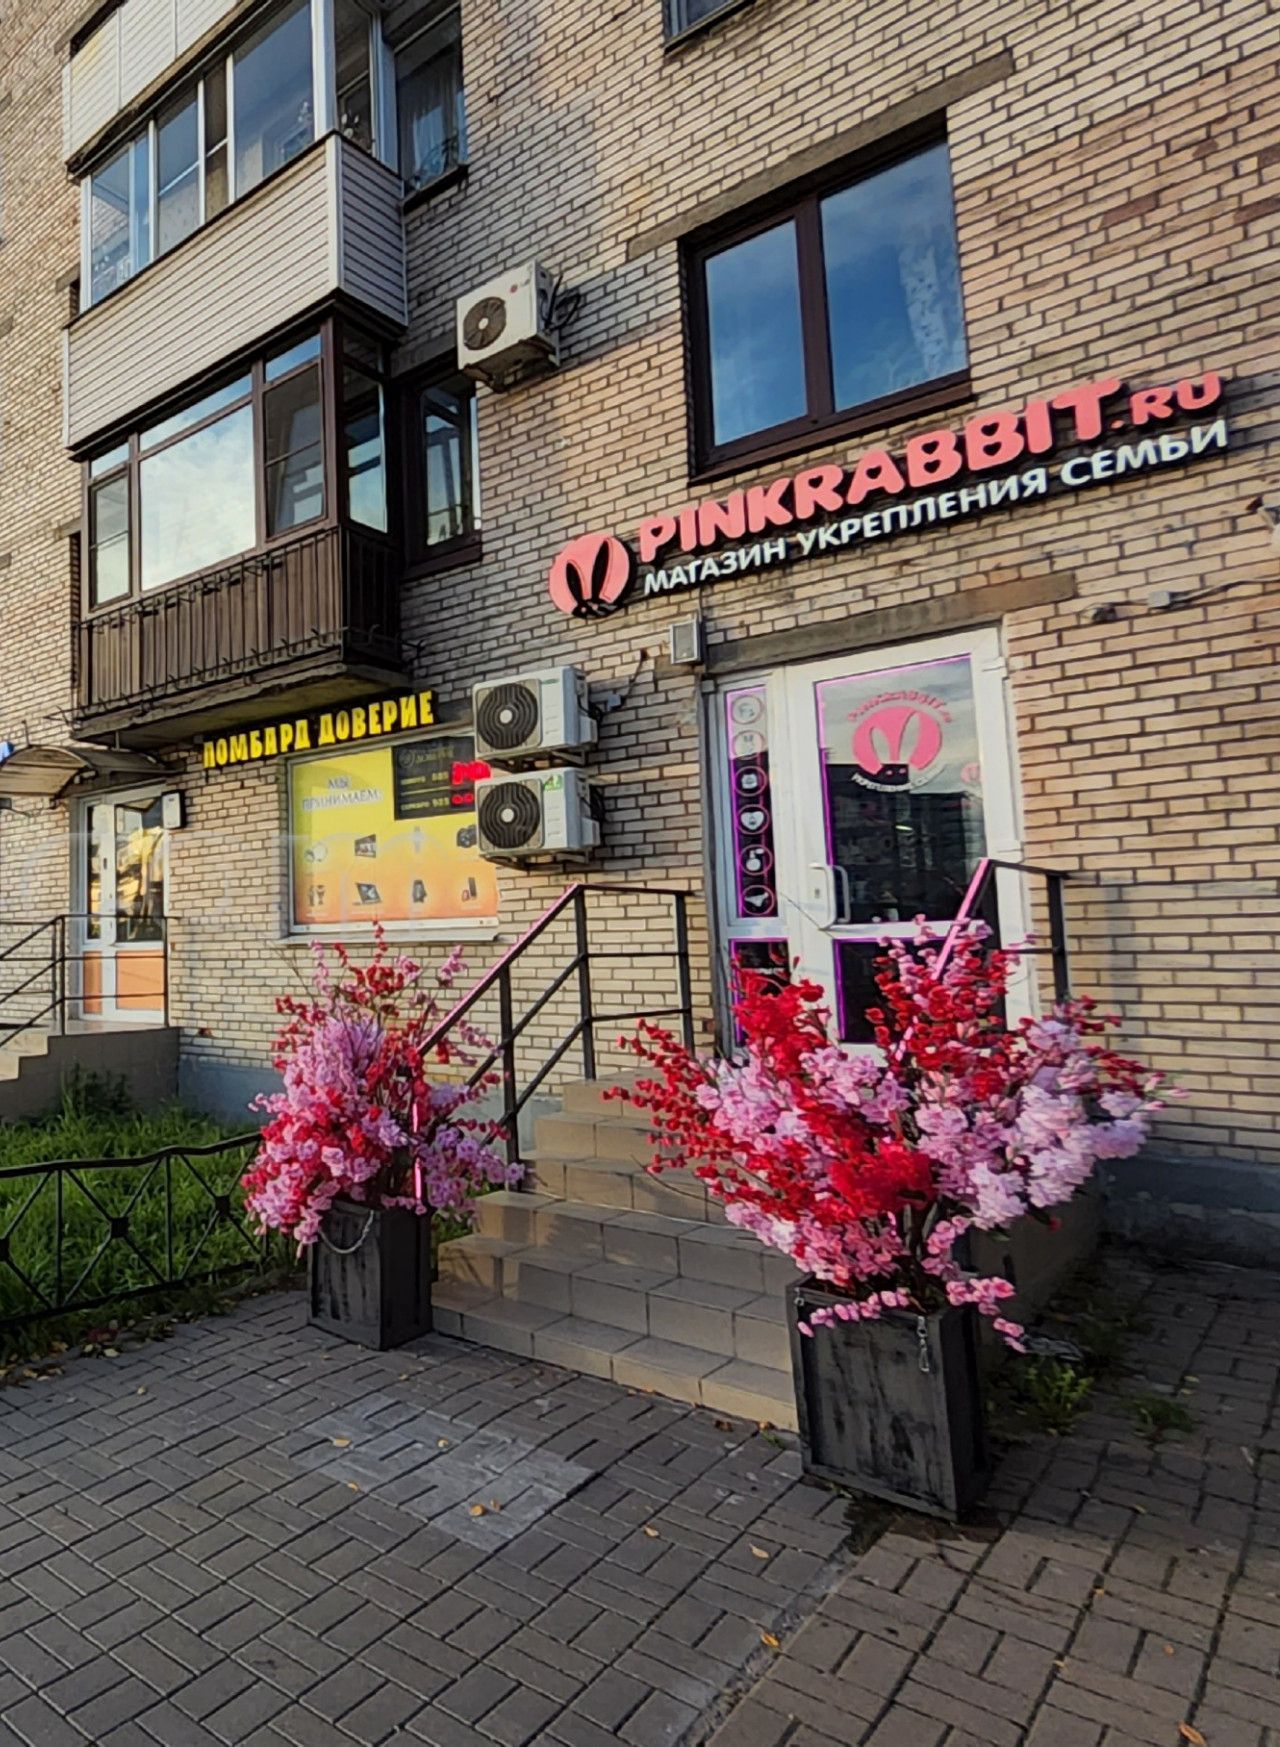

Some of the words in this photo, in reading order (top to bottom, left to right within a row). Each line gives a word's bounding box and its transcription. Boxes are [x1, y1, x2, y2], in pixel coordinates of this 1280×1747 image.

[639, 372, 1222, 563] PINKRABBIT.RU
[643, 539, 786, 595] МАГАЗИН
[797, 468, 1048, 556] УКРЕПЛЕНИЯ
[1060, 419, 1229, 487] СЕМЬИ
[318, 690, 434, 746] ДОВЕРИЕ
